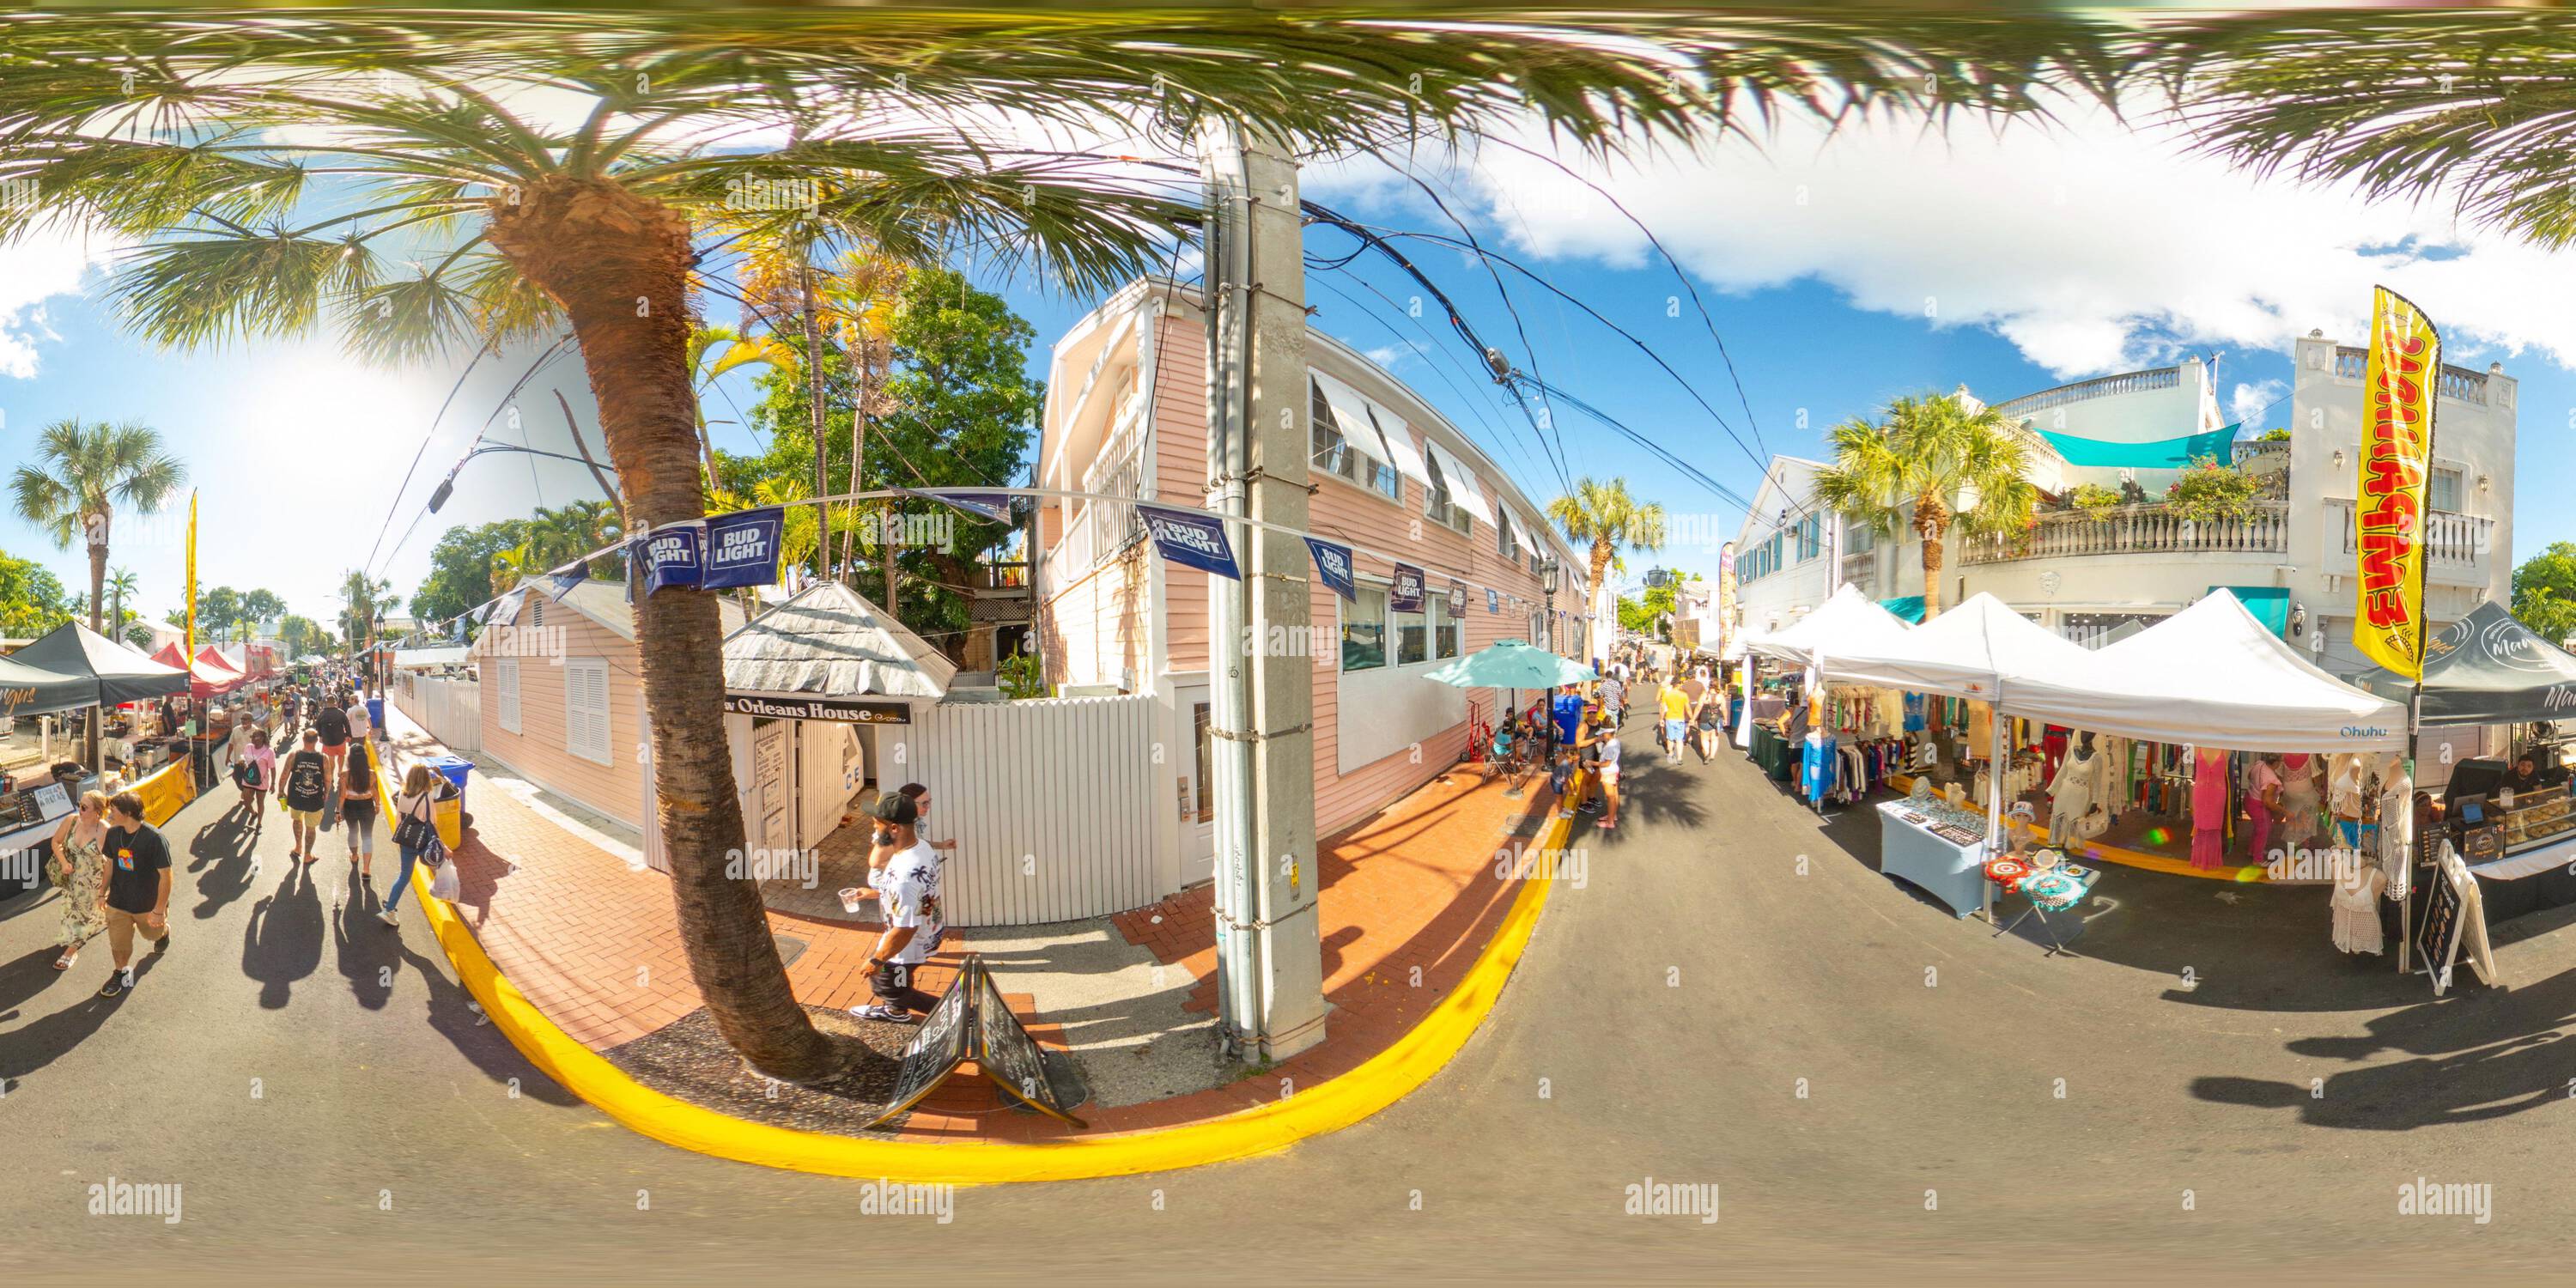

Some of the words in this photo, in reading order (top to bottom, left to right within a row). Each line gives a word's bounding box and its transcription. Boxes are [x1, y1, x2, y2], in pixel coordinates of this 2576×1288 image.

[723, 527, 760, 547] BUD
[1165, 521, 1209, 541] BUD
[1163, 529, 1220, 554] LIGHT
[716, 541, 767, 563] LIGHT
[1321, 548, 1344, 567] BUD
[1321, 556, 1349, 580] LIGHT
[1401, 576, 1417, 587] BUD
[1397, 586, 1421, 598] LIGHT
[738, 698, 807, 718] Orleans
[809, 702, 872, 721] House
[2341, 726, 2387, 737] Ohuhu
